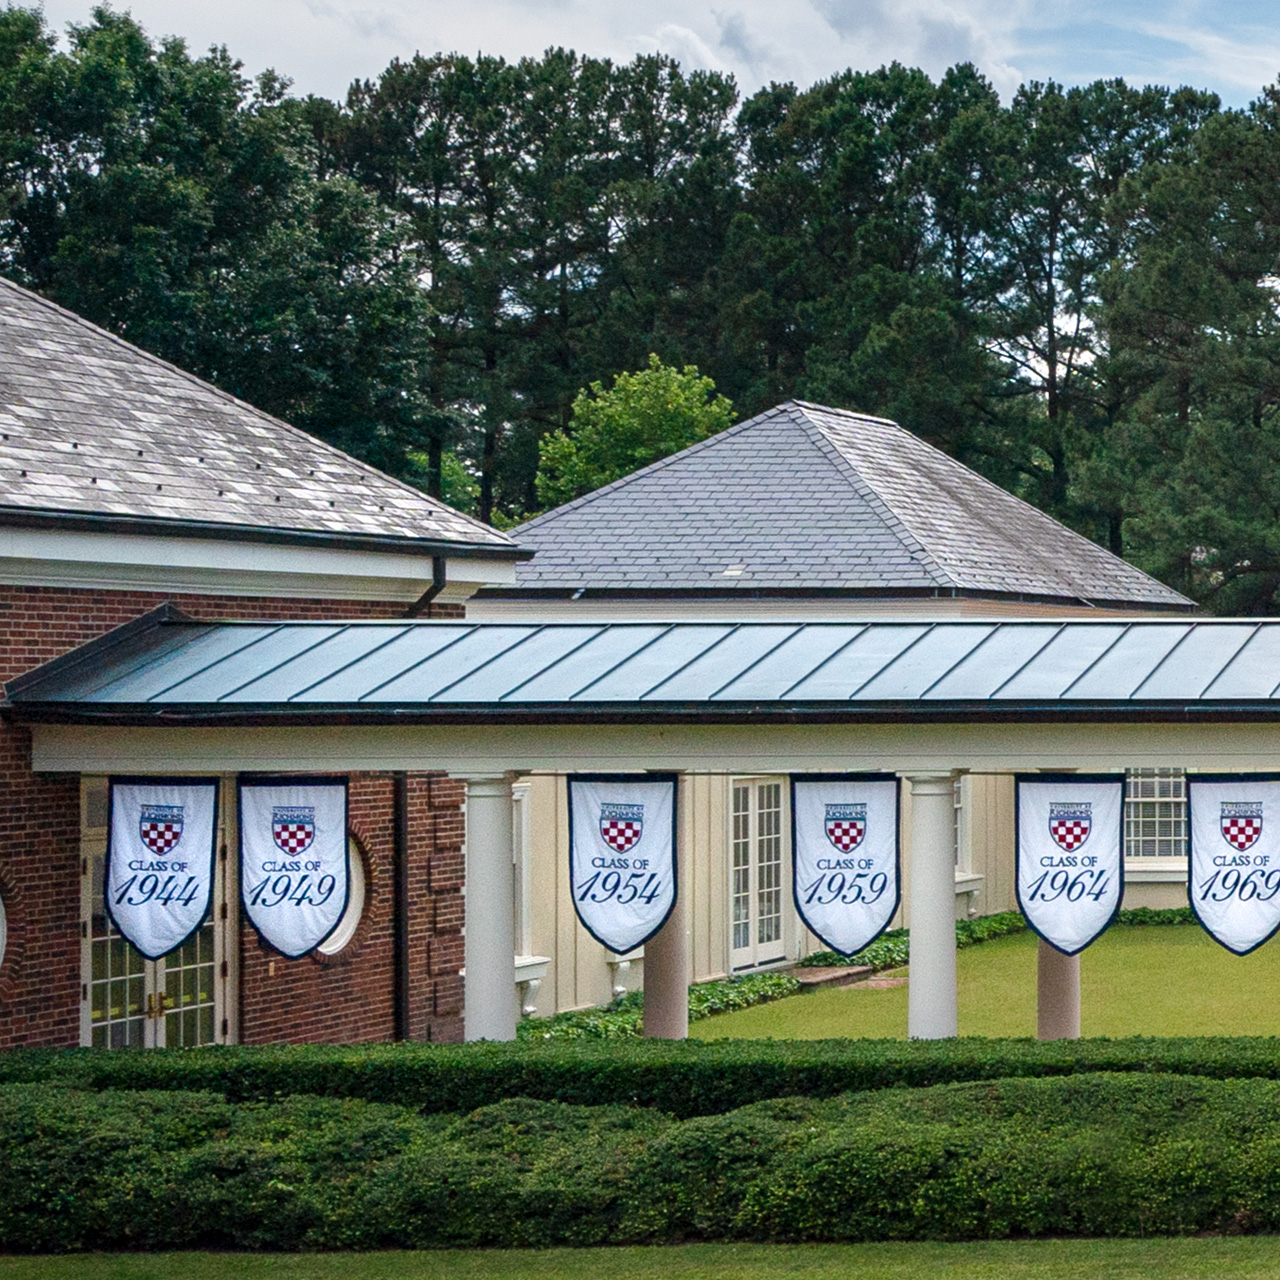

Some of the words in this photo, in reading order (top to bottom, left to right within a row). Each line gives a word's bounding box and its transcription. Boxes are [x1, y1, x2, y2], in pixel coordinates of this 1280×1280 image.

[601, 809, 643, 818] RICHMOND
[826, 810, 867, 818] RICHMOND
[1050, 809, 1092, 817] RICHMOND
[128, 860, 167, 871] CLASS
[171, 862, 187, 872] OF
[592, 857, 629, 869] CLASS
[633, 859, 649, 870] OF
[817, 859, 854, 870] CLASS
[858, 859, 873, 869] OF
[1040, 856, 1077, 867] CLASS
[1081, 856, 1097, 867] OF
[1213, 855, 1250, 866] CLASS
[1254, 856, 1269, 866] OF
[262, 861, 301, 872] CLASS
[305, 861, 321, 871] OF
[115, 874, 199, 906] 1944
[250, 875, 335, 906] 1949
[577, 871, 661, 904] 1954
[804, 872, 887, 904] 1959
[1028, 870, 1107, 902] 1964
